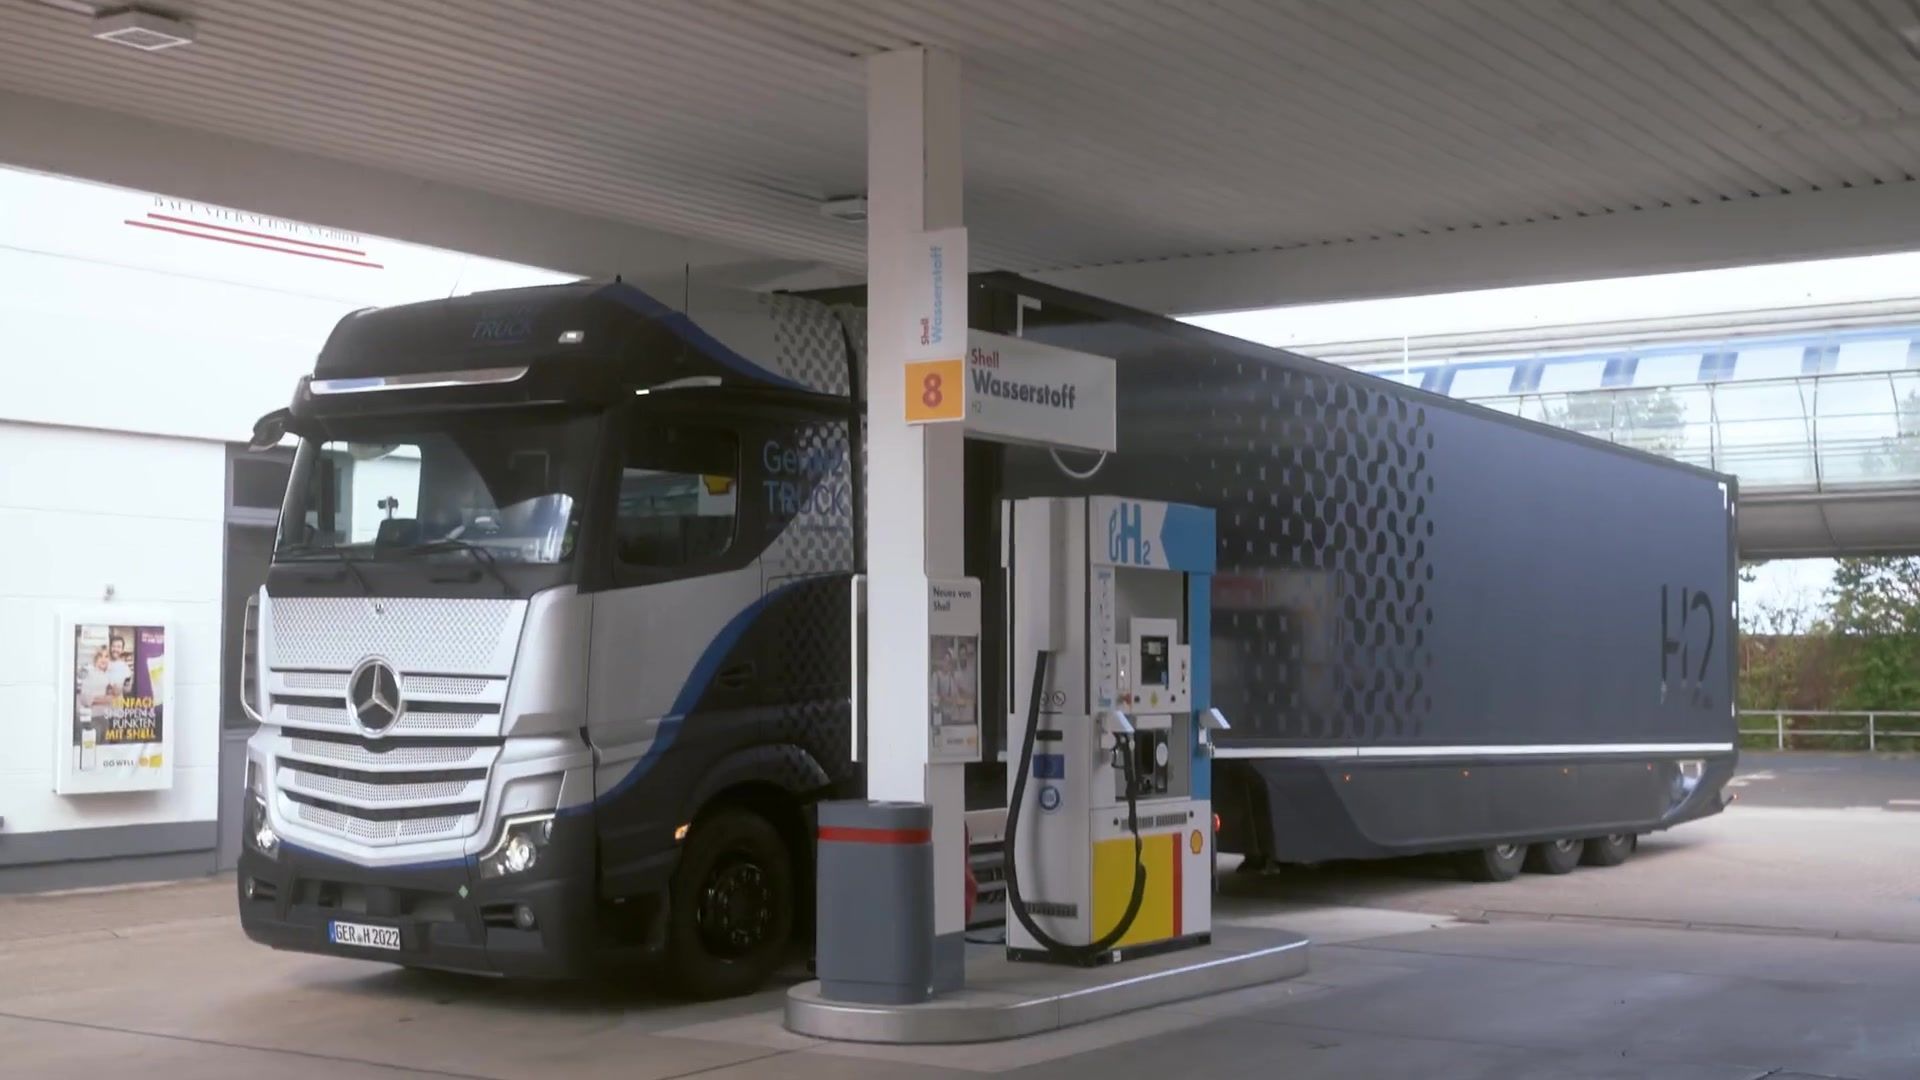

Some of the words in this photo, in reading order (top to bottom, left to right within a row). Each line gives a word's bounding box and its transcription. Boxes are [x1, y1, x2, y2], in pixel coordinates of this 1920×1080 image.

[930, 246, 942, 344] Wasserstoff
[920, 318, 930, 345] Shell
[971, 348, 999, 368] Shell
[922, 373, 943, 408] 8
[972, 368, 1076, 410] Wasserstoff
[763, 481, 849, 516] TRUCK
[933, 587, 956, 599] Neues
[958, 589, 972, 599] von
[933, 601, 951, 612] Shell
[105, 729, 123, 740] MIT
[127, 728, 156, 739] SHELL
[113, 718, 156, 729] PUNKTEN
[336, 924, 356, 942] GER
[363, 927, 370, 944] H
[372, 928, 399, 947] 2022
